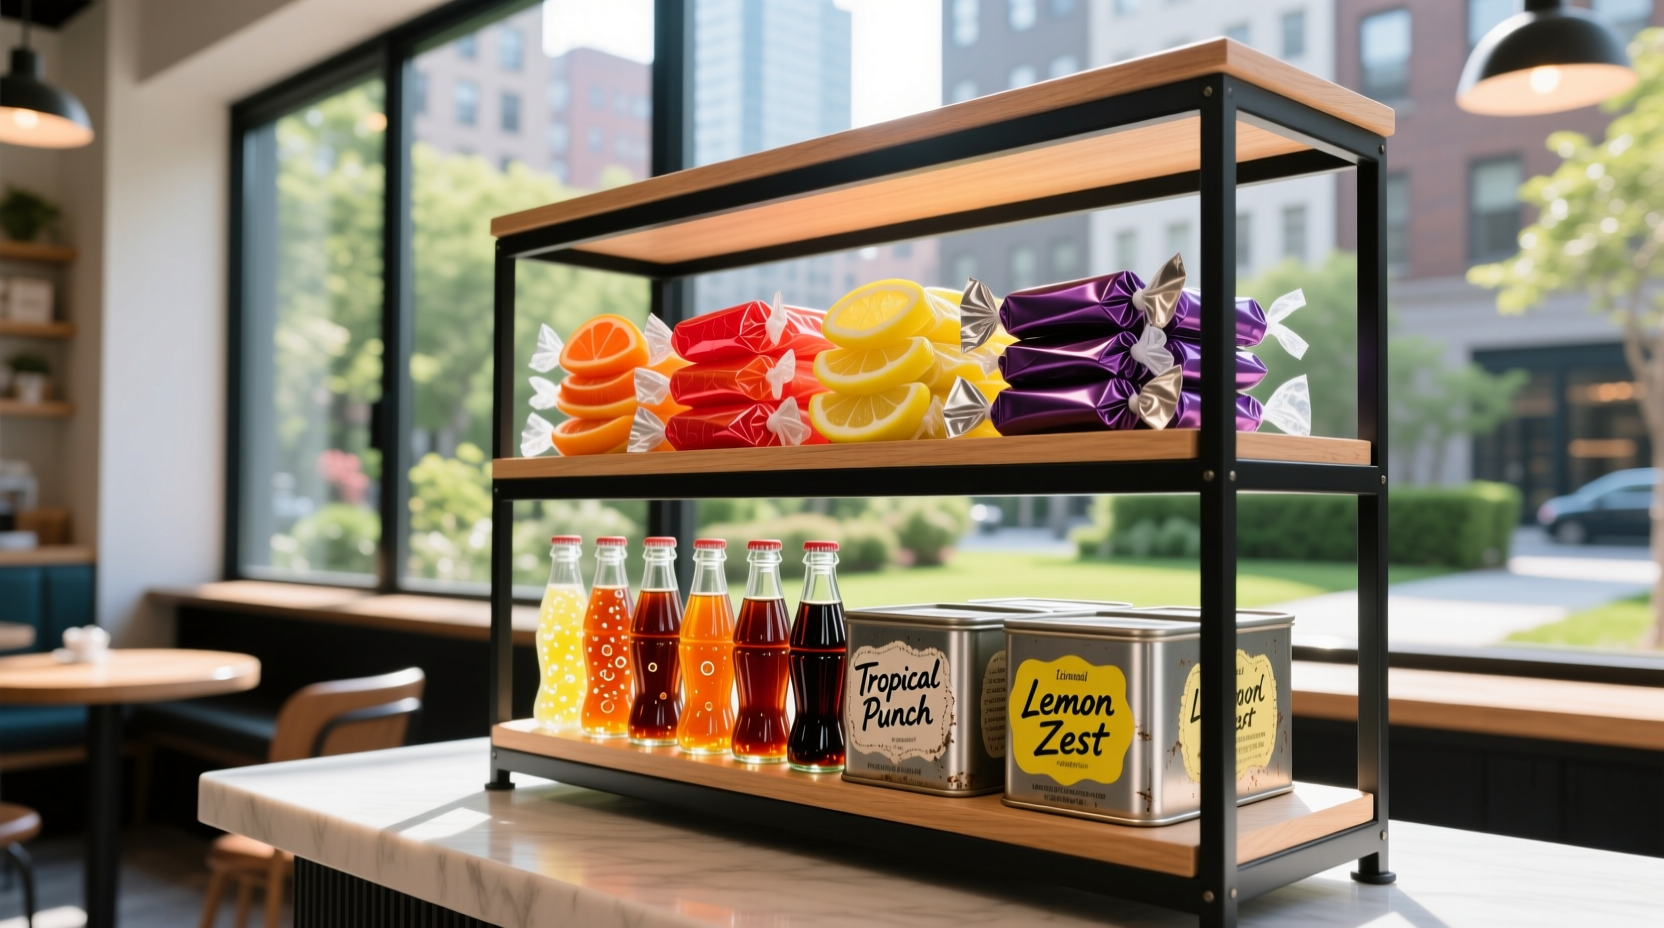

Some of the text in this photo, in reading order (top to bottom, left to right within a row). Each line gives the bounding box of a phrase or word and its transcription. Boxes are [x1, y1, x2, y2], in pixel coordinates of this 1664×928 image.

[855, 658, 940, 702] Tropical
[1021, 678, 1115, 719] Lemon
[863, 694, 933, 731] Punch
[1033, 720, 1110, 757] Zest
